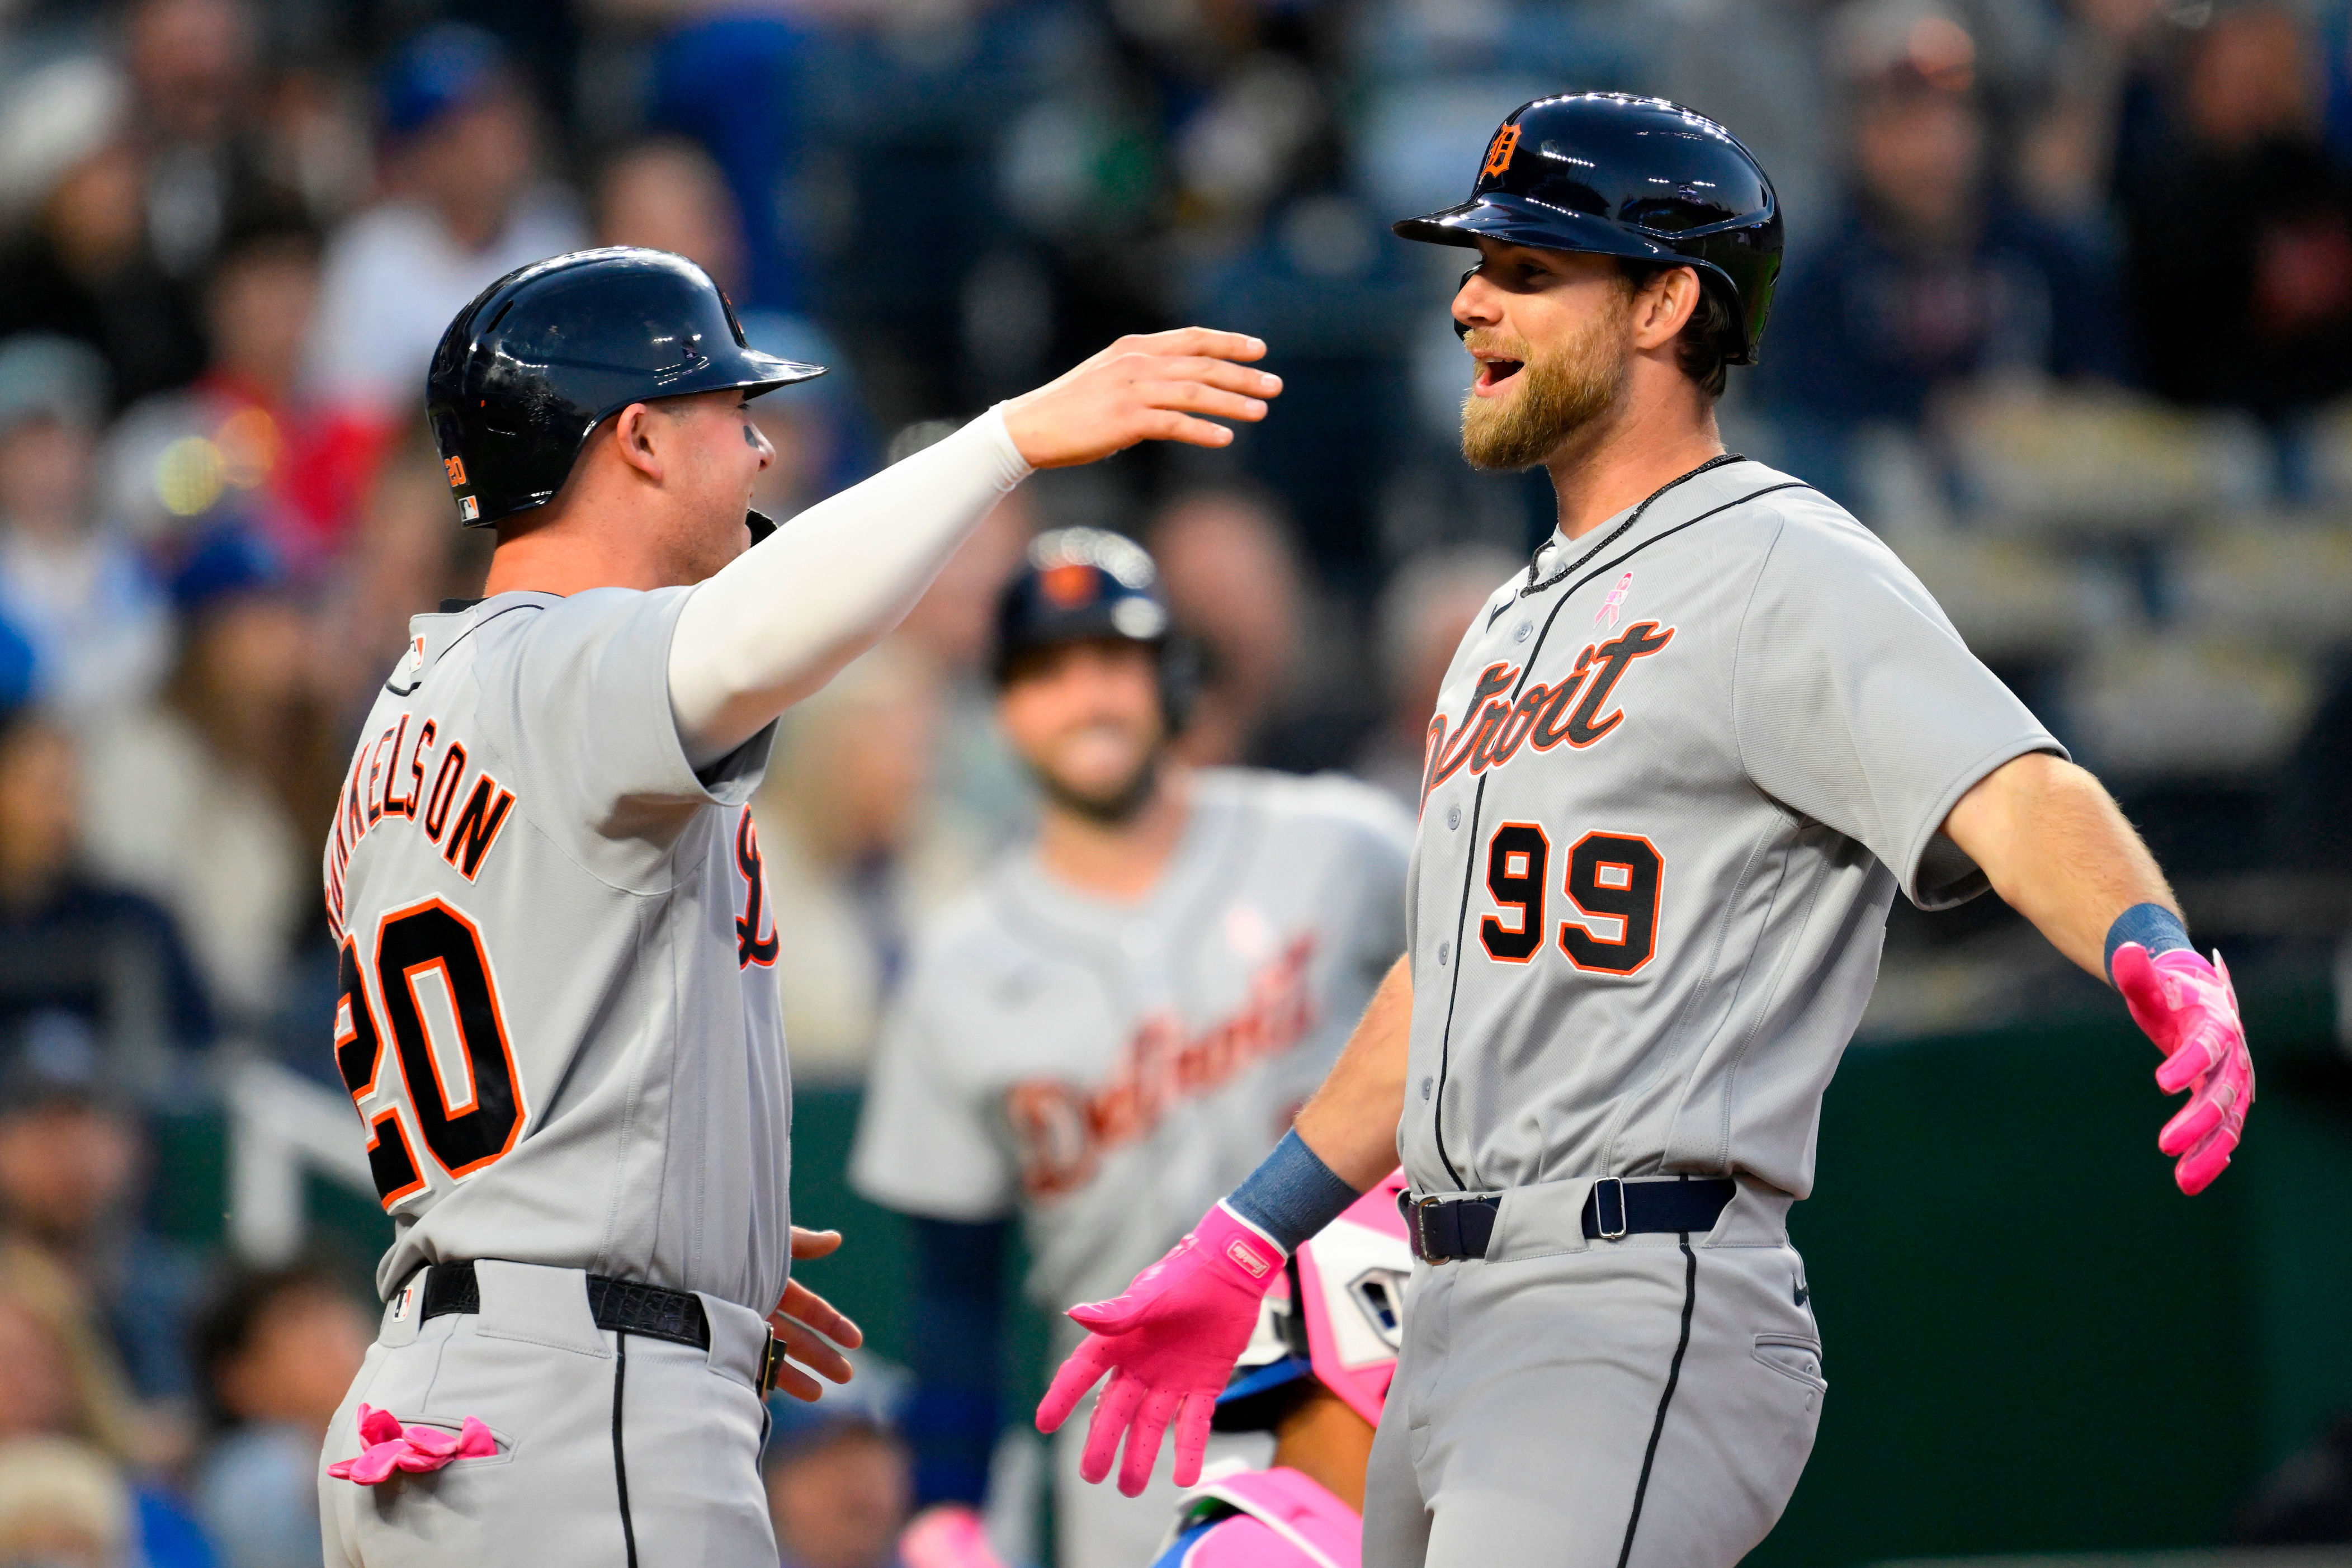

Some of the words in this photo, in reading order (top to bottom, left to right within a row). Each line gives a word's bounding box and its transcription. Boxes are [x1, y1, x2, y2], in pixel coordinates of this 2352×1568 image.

[444, 455, 466, 487] 20
[1419, 620, 1677, 824] troit
[1479, 820, 1666, 977] 99
[334, 893, 531, 1215] 20
